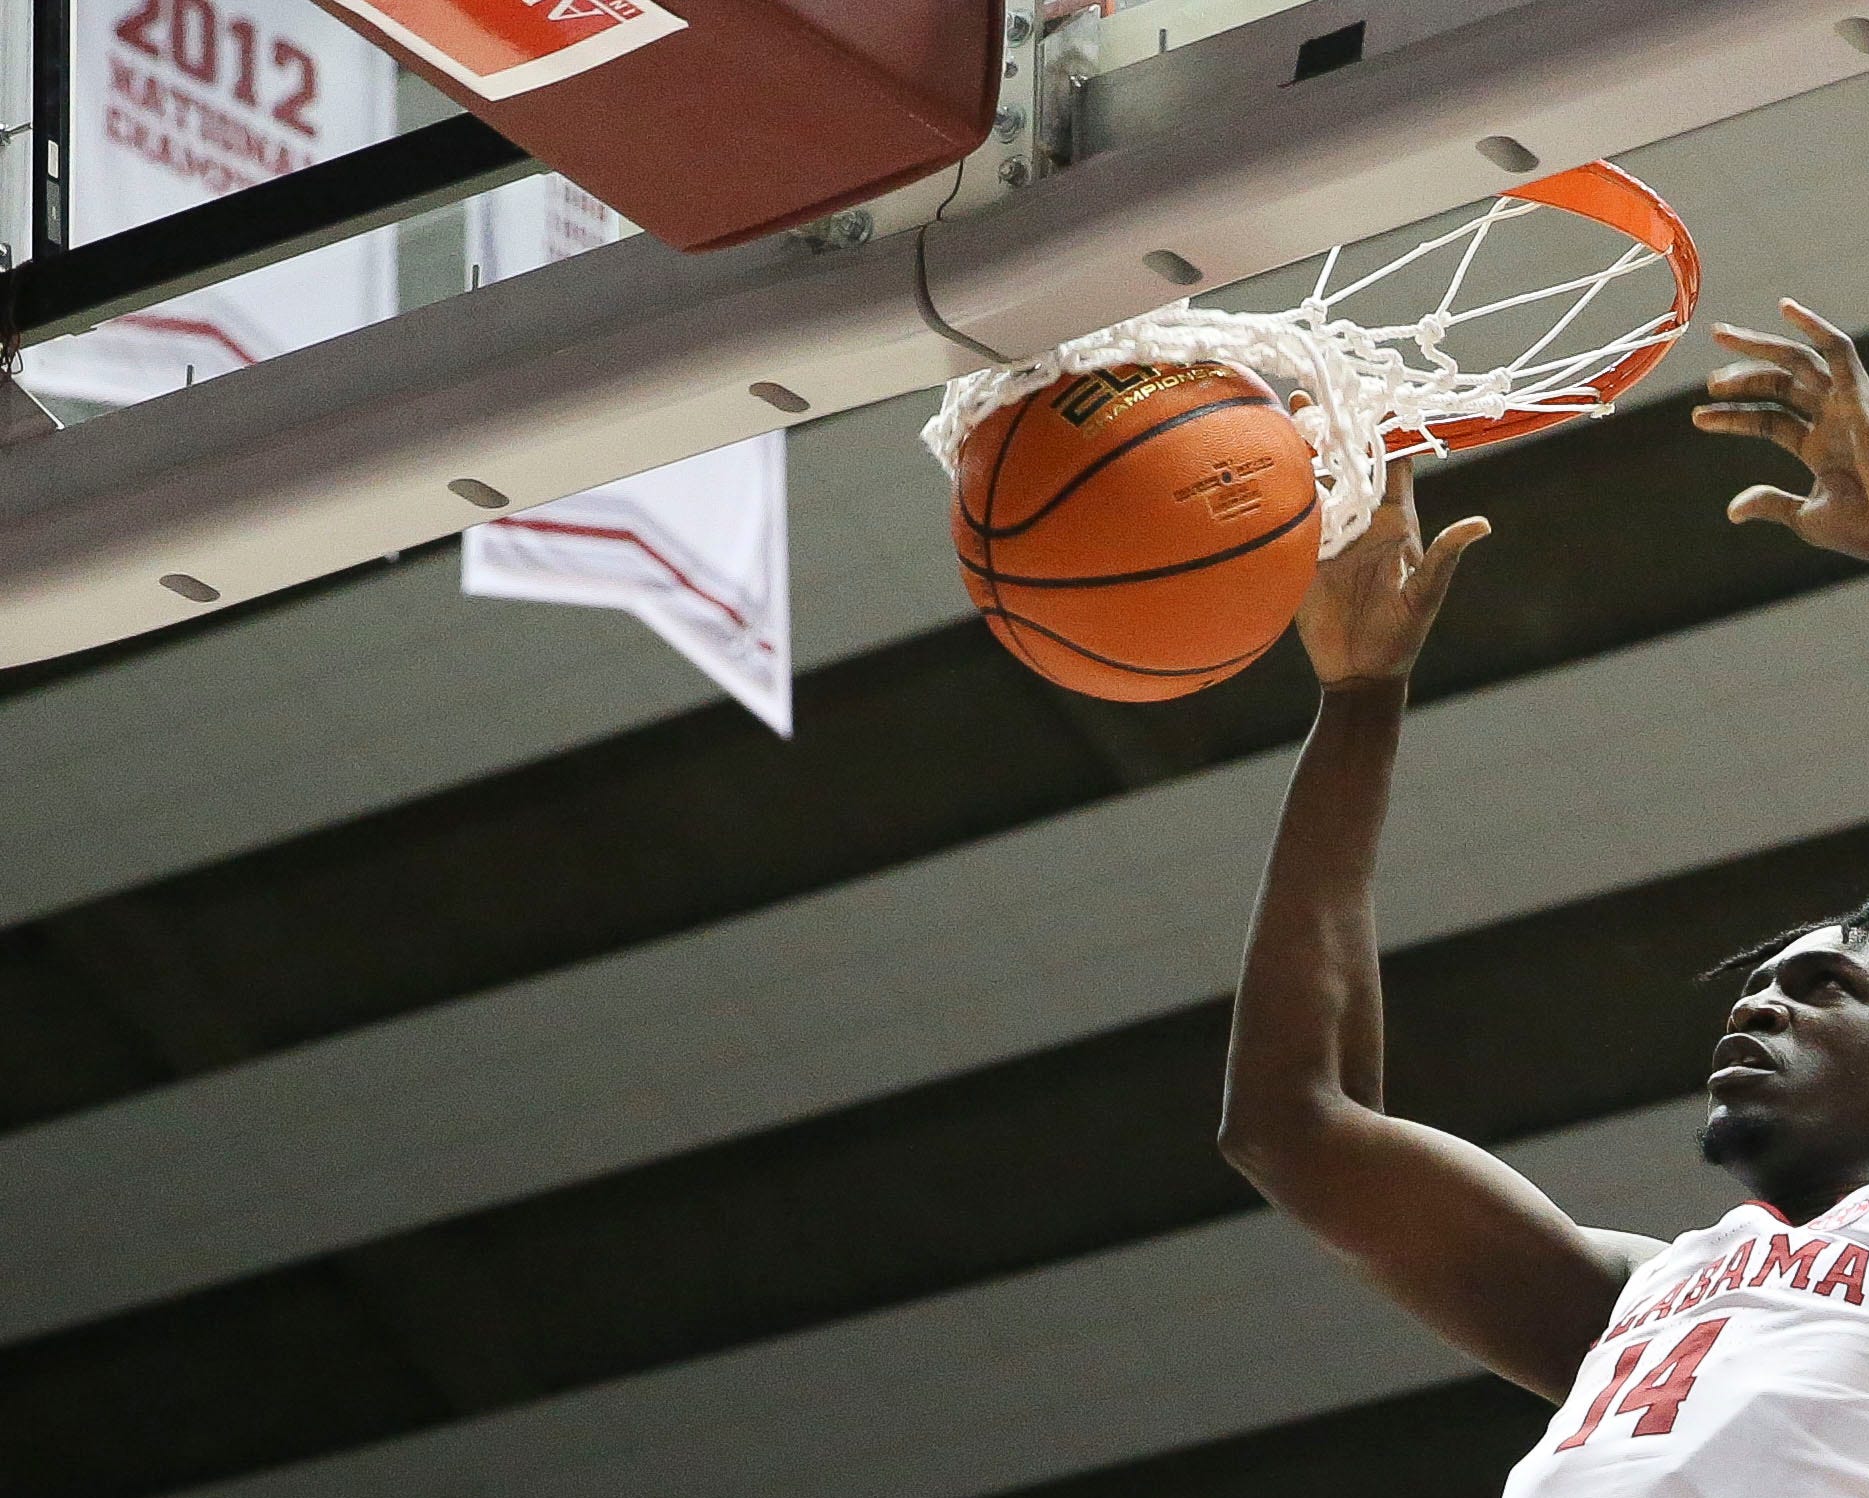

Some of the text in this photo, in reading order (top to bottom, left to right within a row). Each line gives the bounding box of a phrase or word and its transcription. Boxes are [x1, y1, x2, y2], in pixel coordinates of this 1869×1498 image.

[107, 52, 314, 173] NATIONA
[116, 0, 318, 137] 2012
[1554, 1317, 1731, 1454] 14
